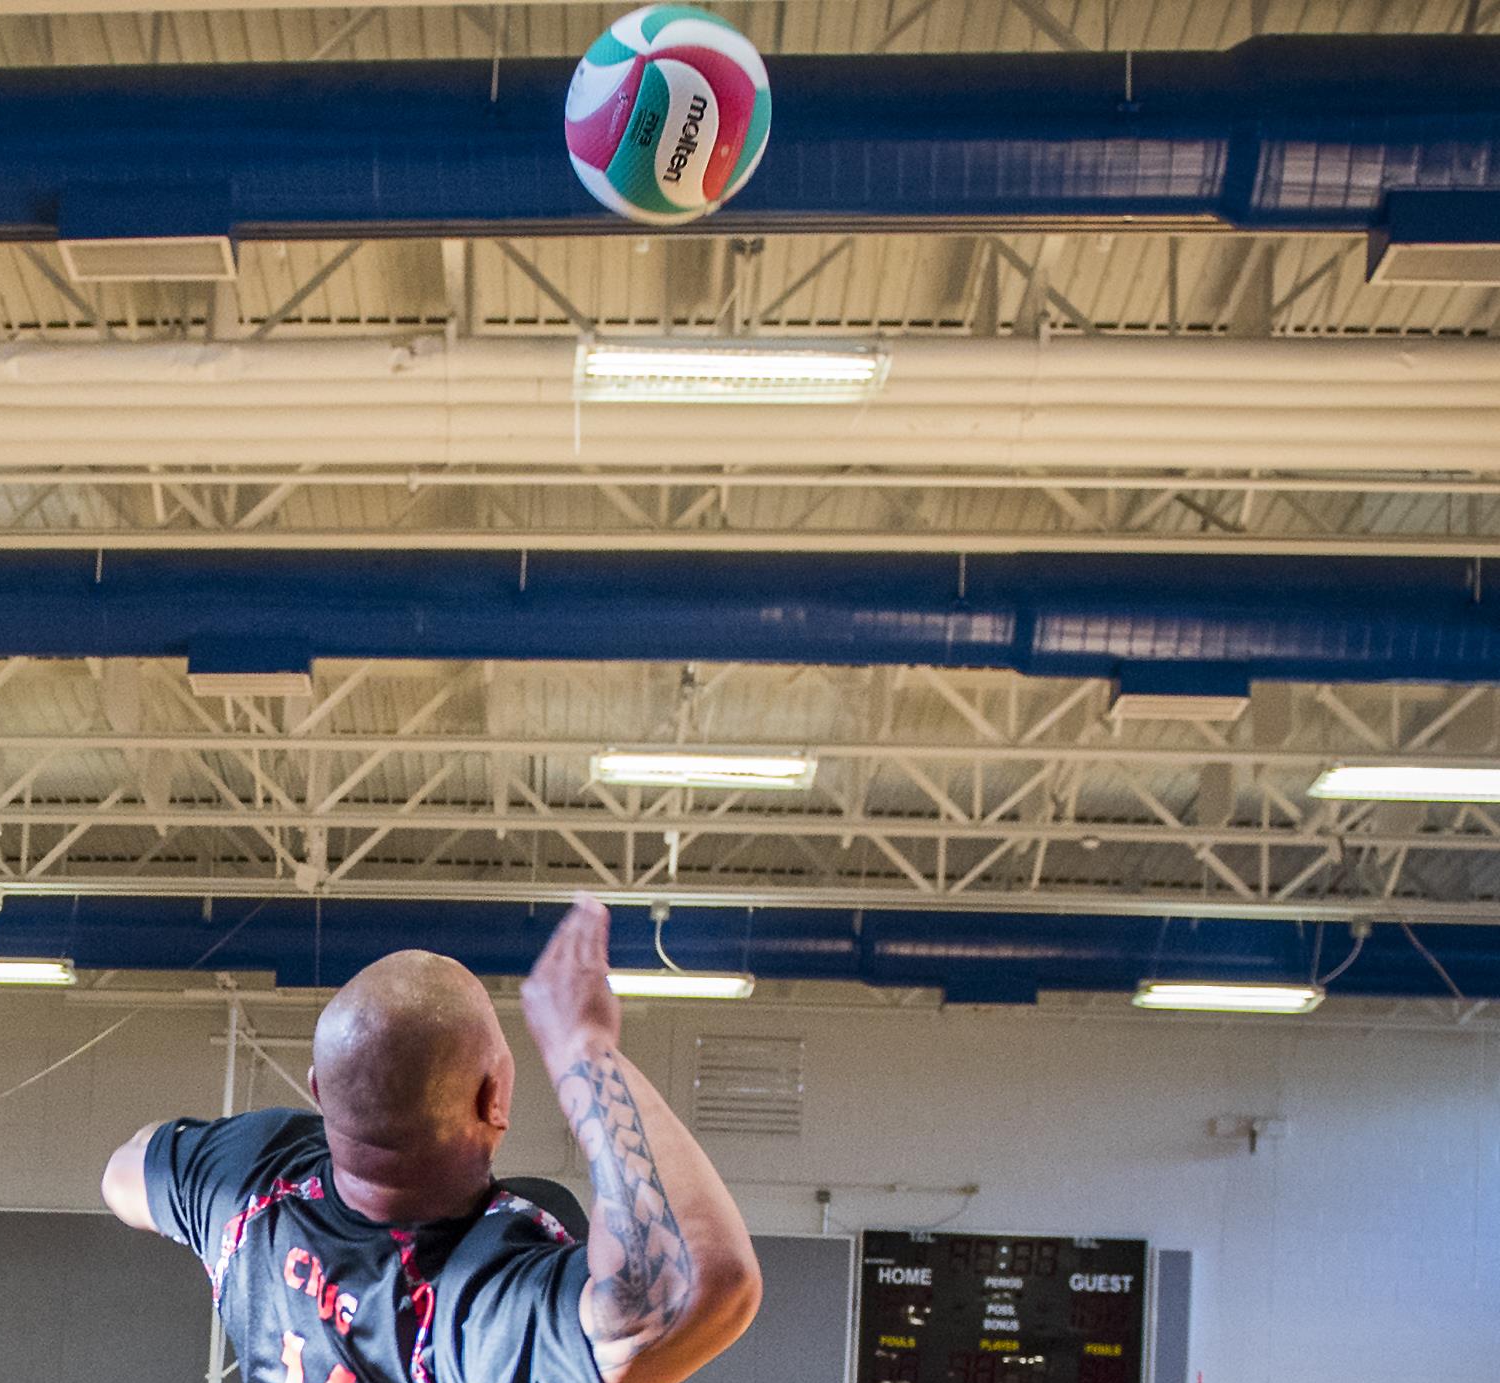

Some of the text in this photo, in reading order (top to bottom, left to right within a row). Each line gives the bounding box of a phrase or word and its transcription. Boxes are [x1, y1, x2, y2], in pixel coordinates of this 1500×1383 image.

[663, 94, 708, 183] molten
[878, 1268, 932, 1286] HOME
[984, 1276, 1024, 1290] PERIOD
[1068, 1273, 1134, 1293] GUEST
[983, 1318, 1020, 1332] BONUS
[879, 1336, 916, 1348] FOULS
[979, 1338, 1020, 1351] PLAYER
[1083, 1343, 1122, 1356] FOULS
